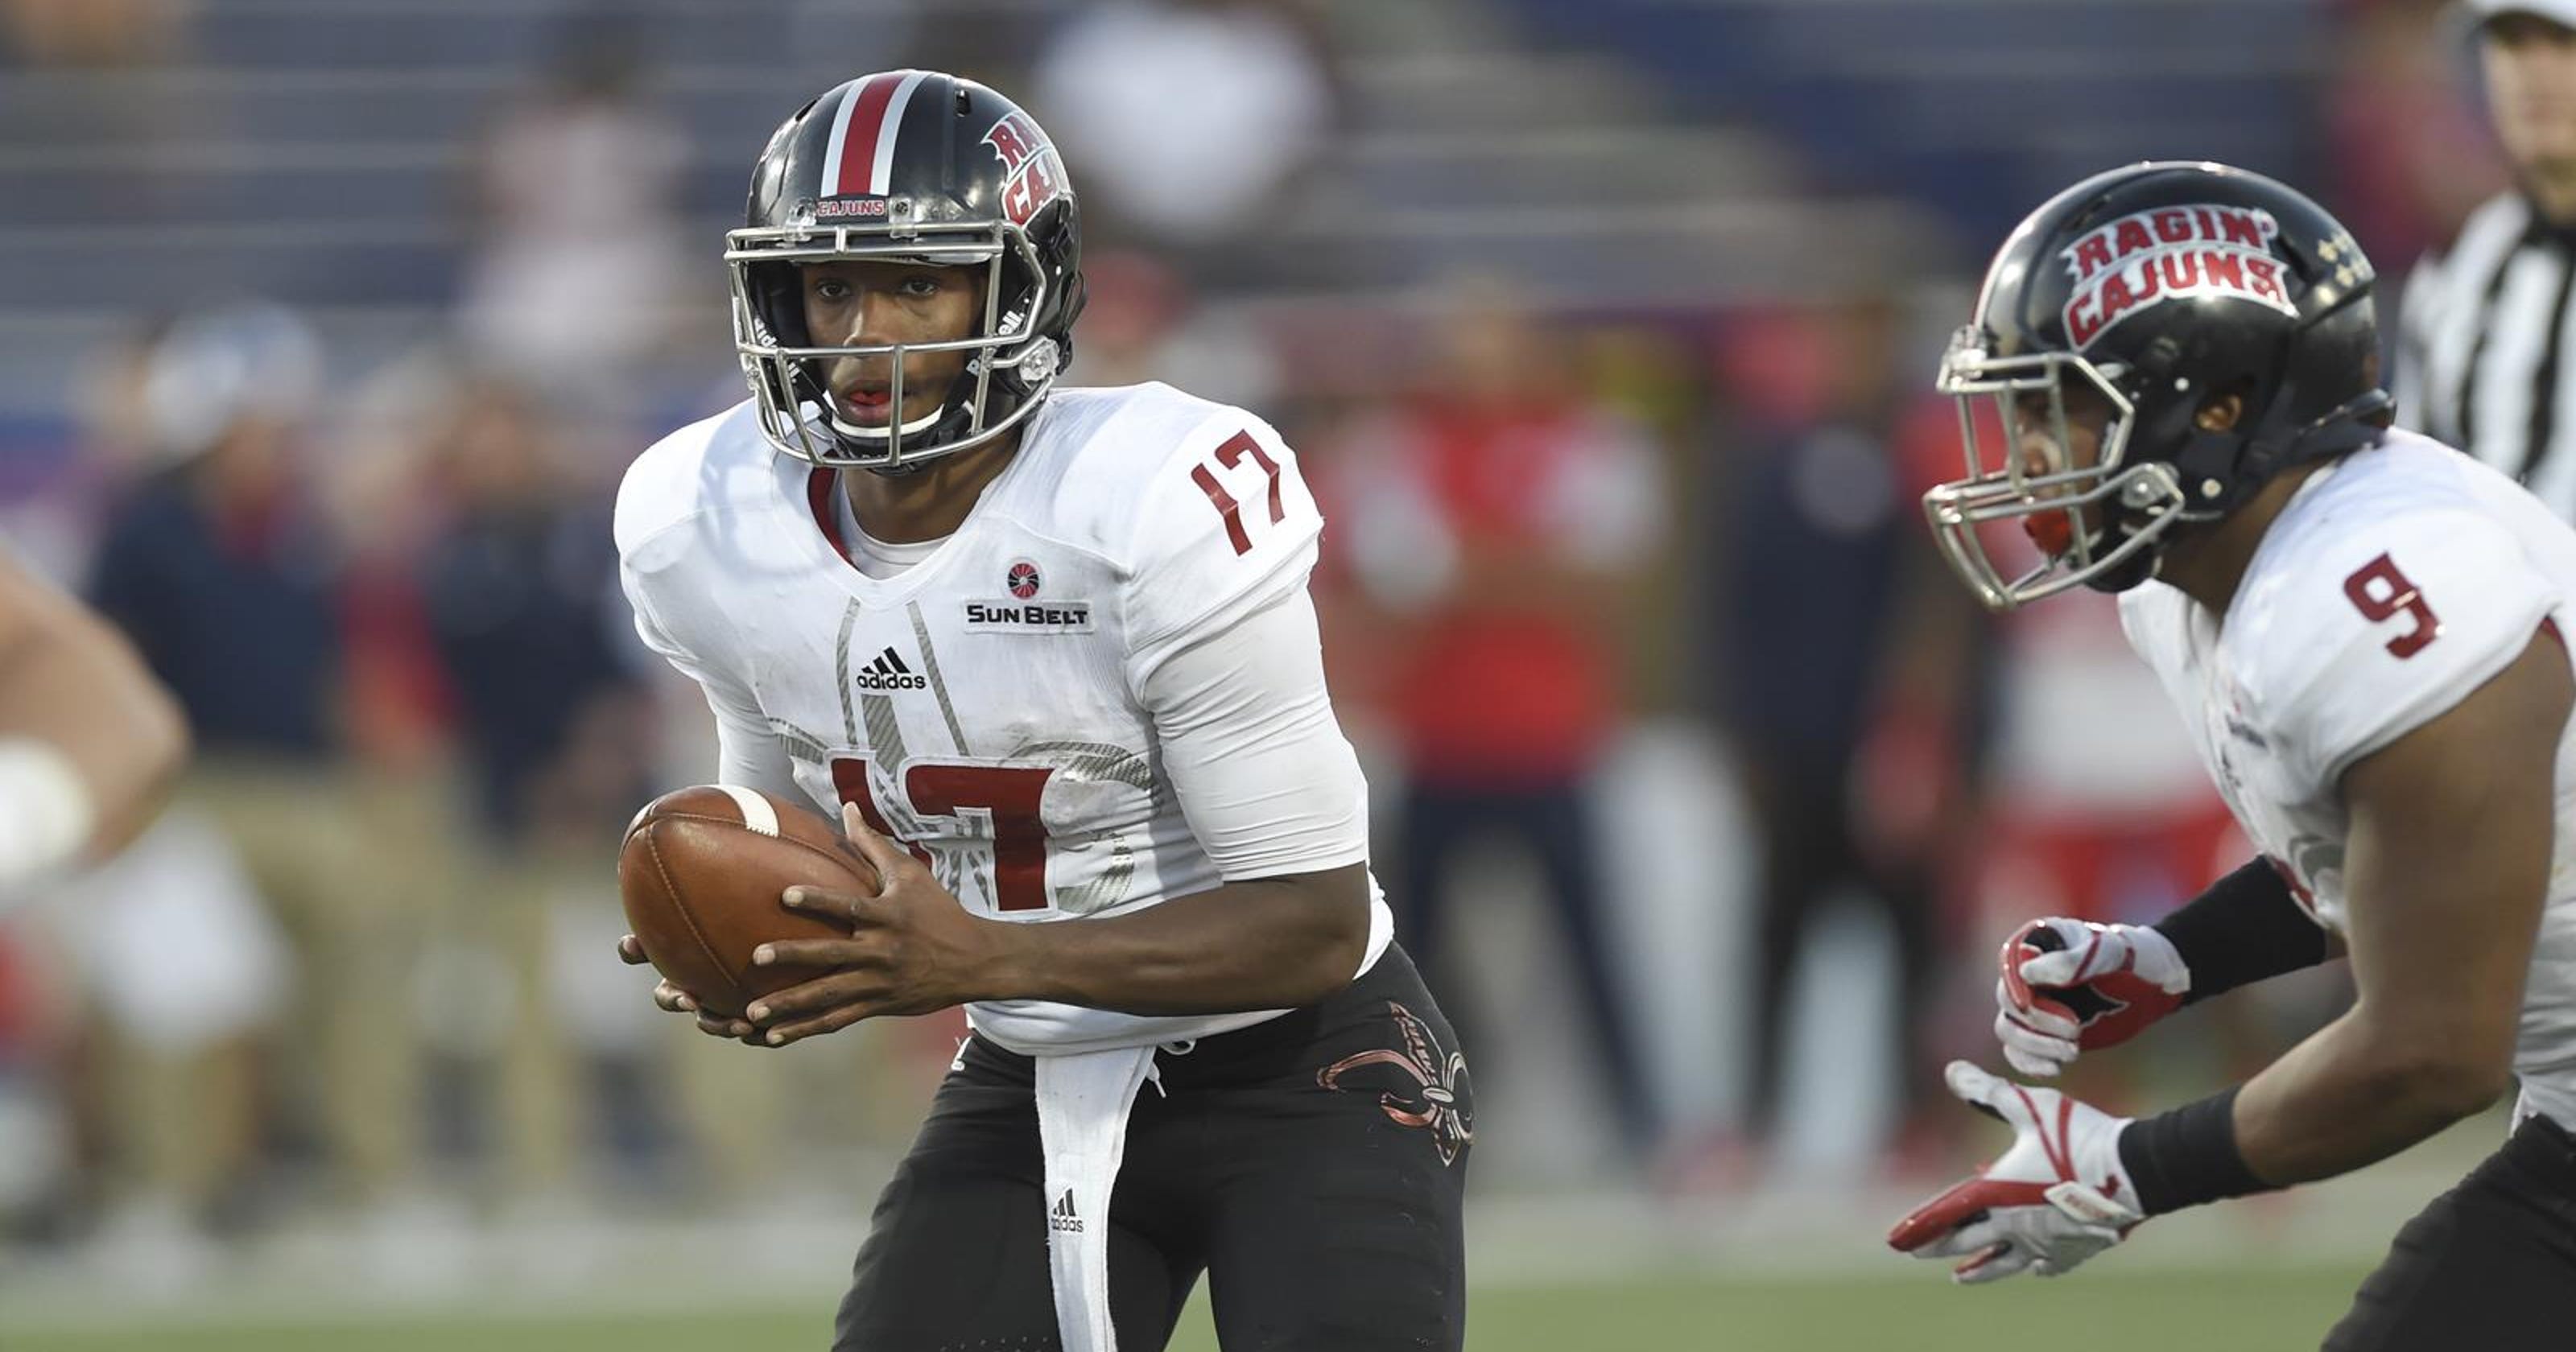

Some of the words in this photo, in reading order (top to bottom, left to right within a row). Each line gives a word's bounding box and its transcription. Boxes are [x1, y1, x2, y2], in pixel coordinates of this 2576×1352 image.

[817, 200, 885, 216] CAJUNS
[2066, 251, 2286, 348] CAJUNS
[1191, 429, 1286, 556] 17
[2344, 551, 2439, 660] 9
[857, 674, 926, 690] adidas
[831, 758, 1055, 912] 17
